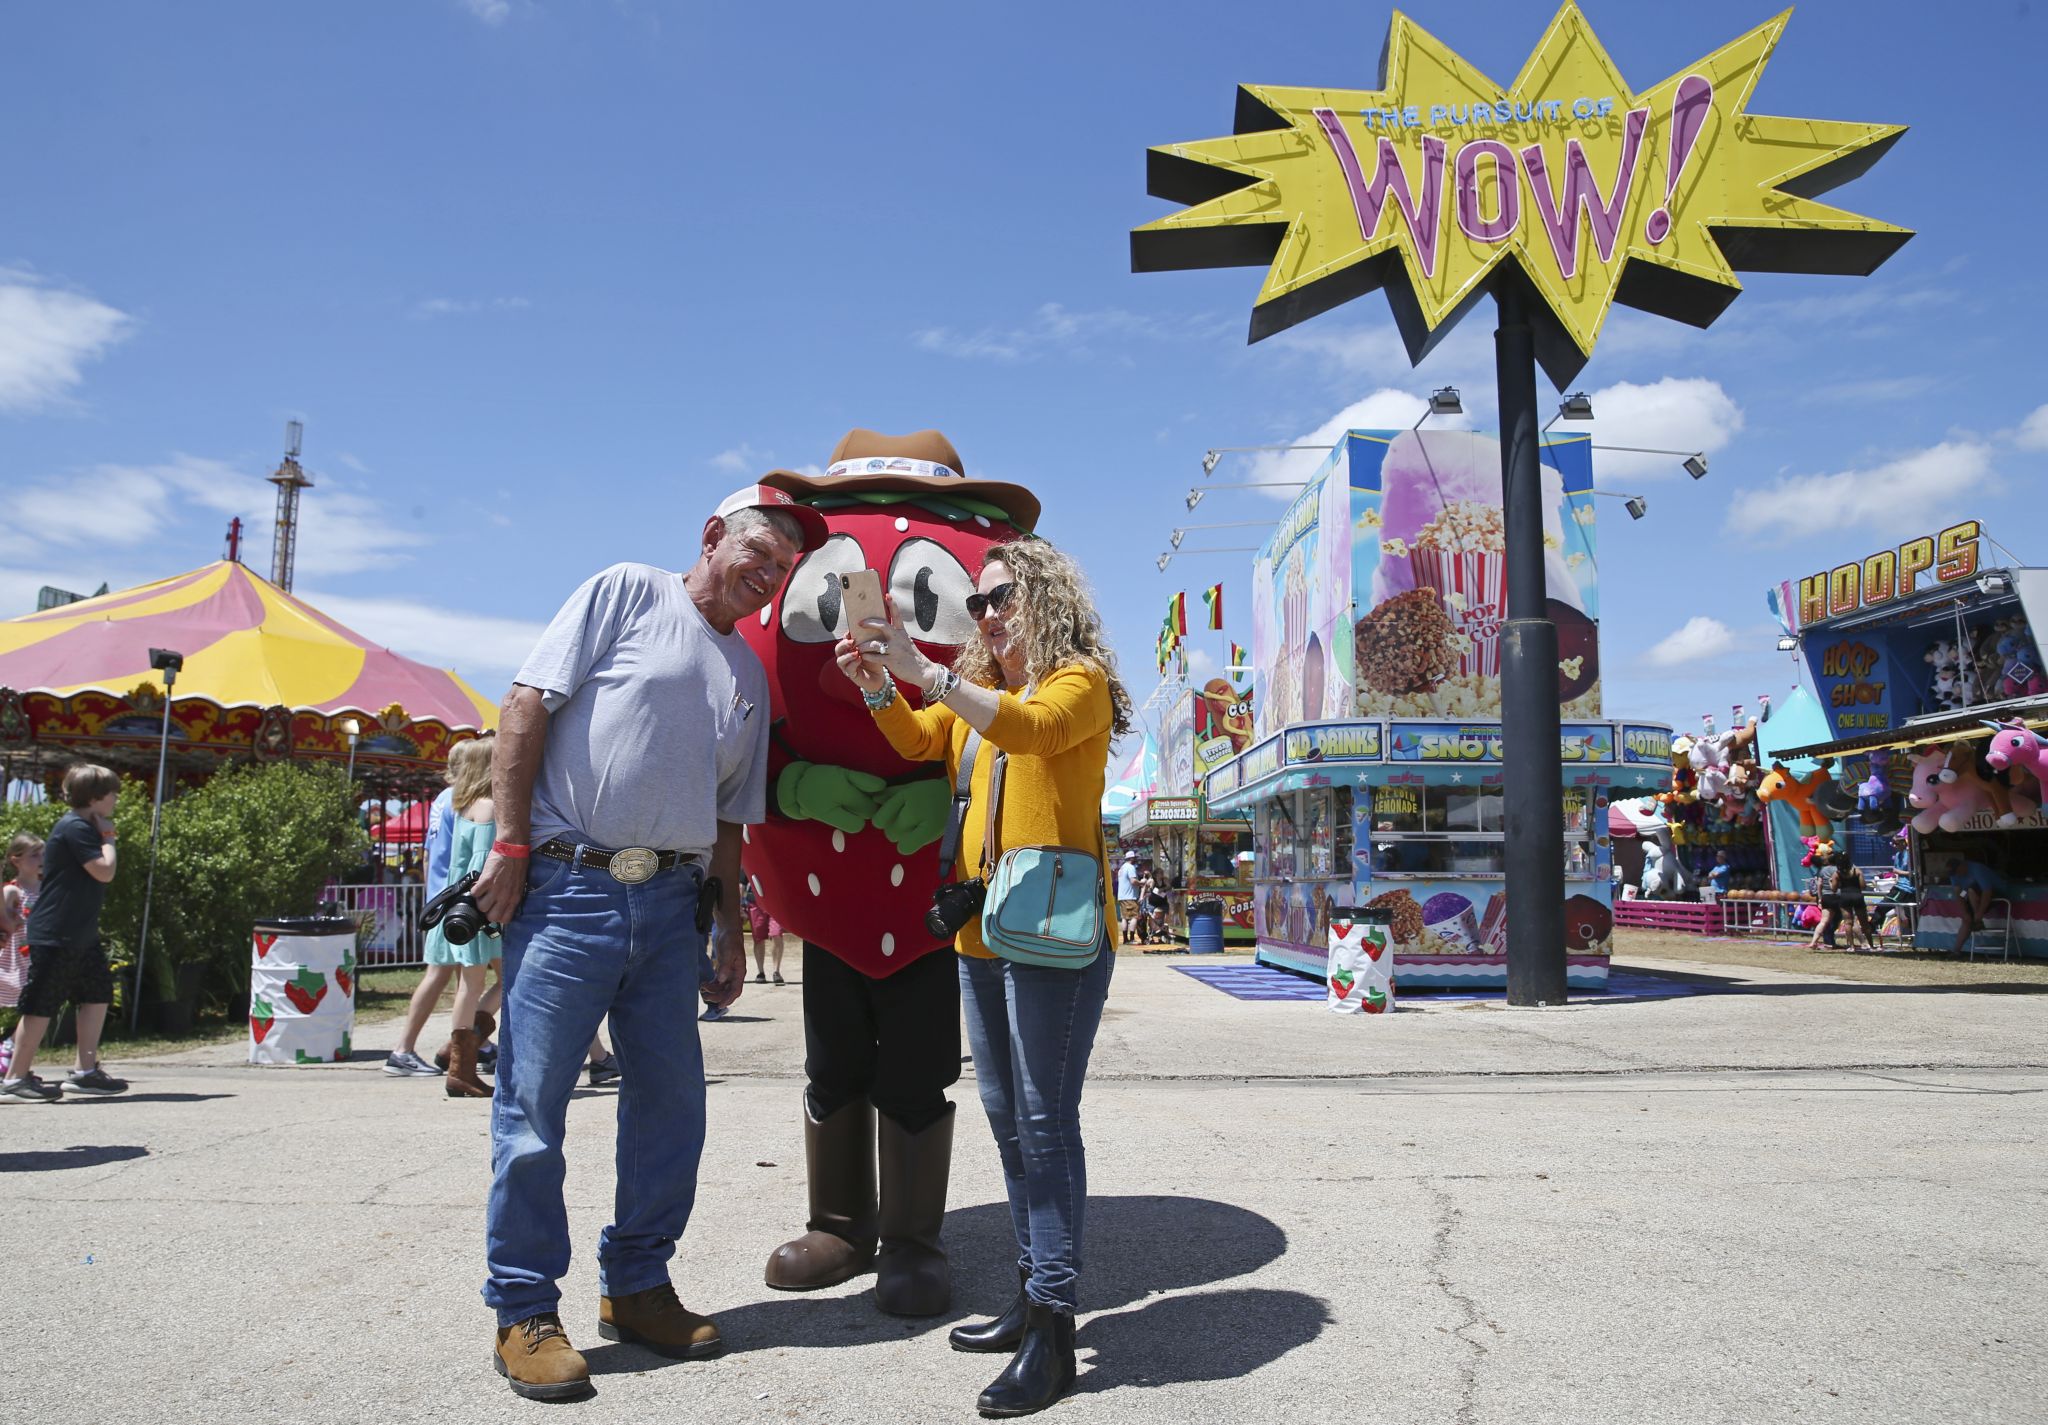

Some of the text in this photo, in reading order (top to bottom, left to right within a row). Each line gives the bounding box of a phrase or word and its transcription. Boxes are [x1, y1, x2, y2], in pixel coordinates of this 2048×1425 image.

[1360, 96, 1615, 129] THE PURSUIT OF
[1312, 74, 1713, 280] WOW!
[1799, 519, 1980, 625] HOOPS
[1461, 603, 1497, 624] POP
[1469, 621, 1502, 643] CO
[1823, 640, 1879, 677] HOOP
[1838, 713, 1855, 729] ONE
[1857, 713, 1865, 729] IN
[1315, 727, 1379, 757] DRINKS
[1460, 728, 1502, 741] RAIN
[1421, 735, 1486, 760] SNO
[1150, 808, 1197, 820] LEMONADE
[1374, 798, 1418, 814] LEMONADE
